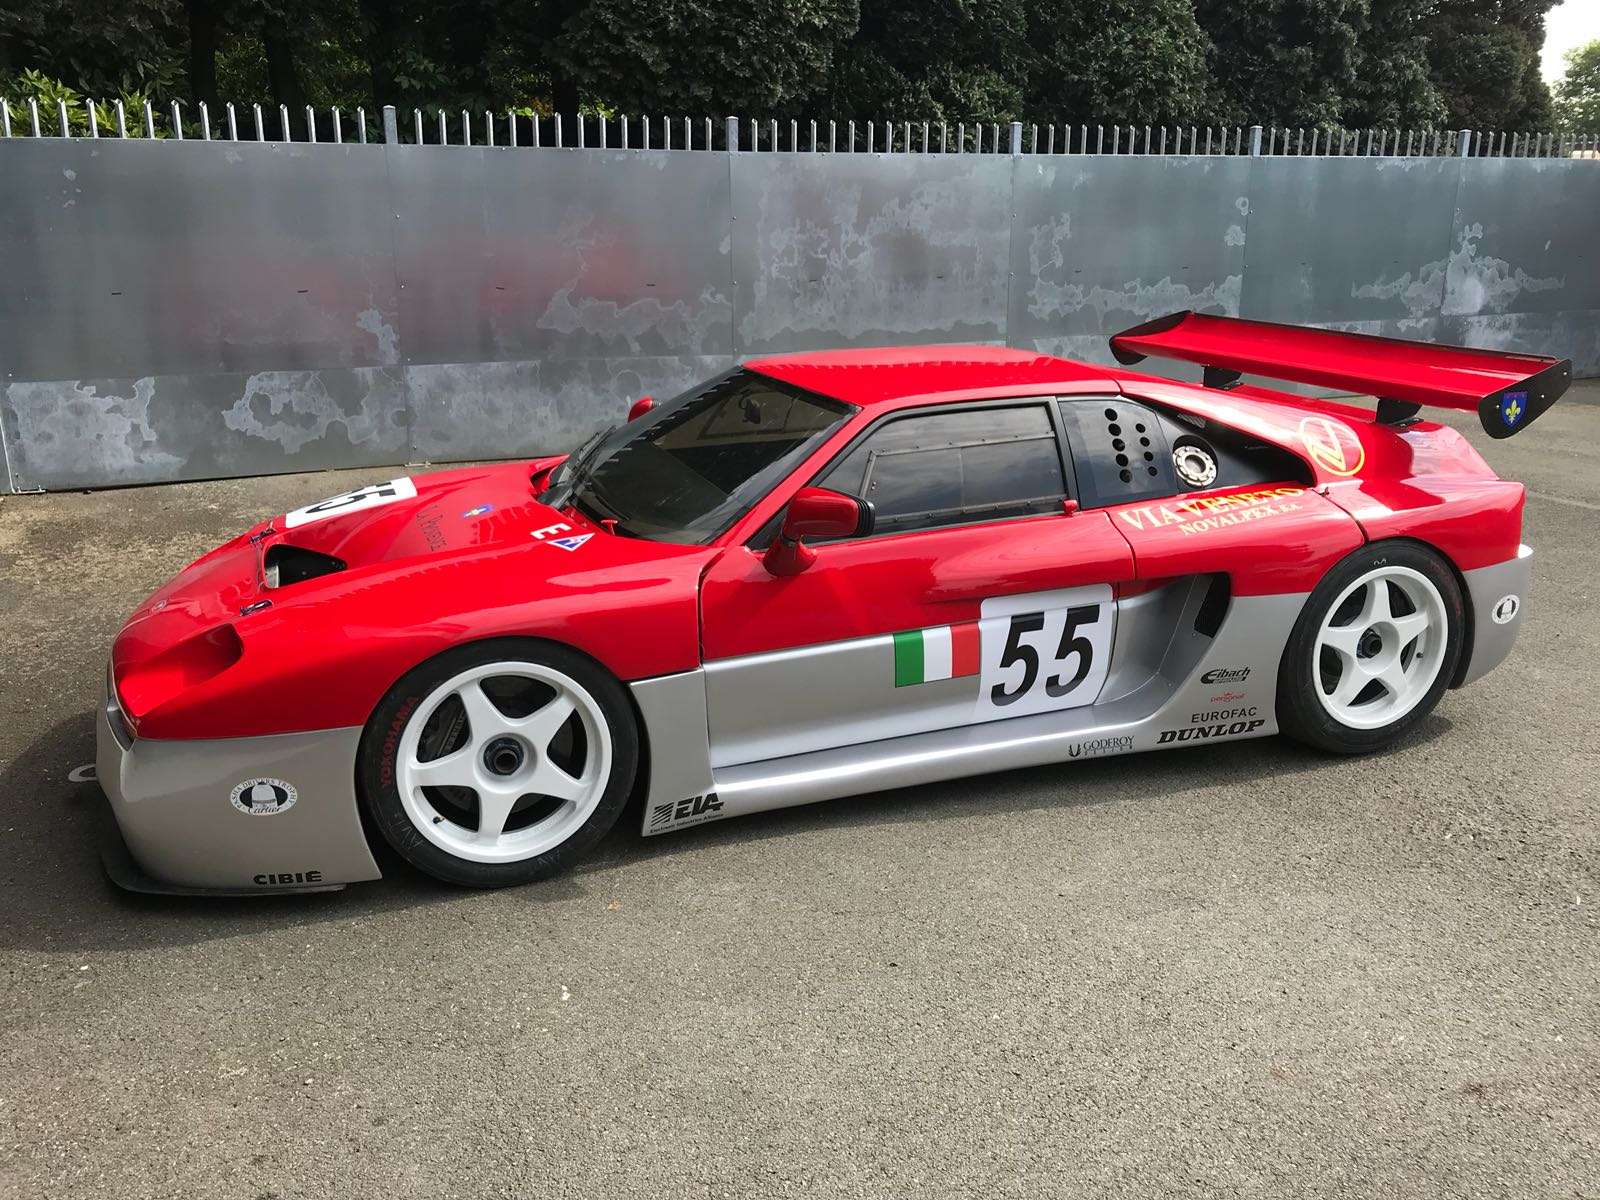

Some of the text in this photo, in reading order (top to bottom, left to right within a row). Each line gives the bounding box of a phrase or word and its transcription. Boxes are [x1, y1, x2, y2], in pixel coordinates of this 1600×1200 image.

[1118, 487, 1304, 531] VIA VENETO
[1178, 505, 1279, 536] NOVALPEX
[530, 523, 573, 540] E
[990, 604, 1100, 707] 55
[1200, 666, 1251, 684] Eibach
[1191, 706, 1257, 724] EUROFAC
[1083, 735, 1135, 751] GODEFROY
[1157, 719, 1265, 745] DUNLOP
[674, 792, 725, 820] EIA
